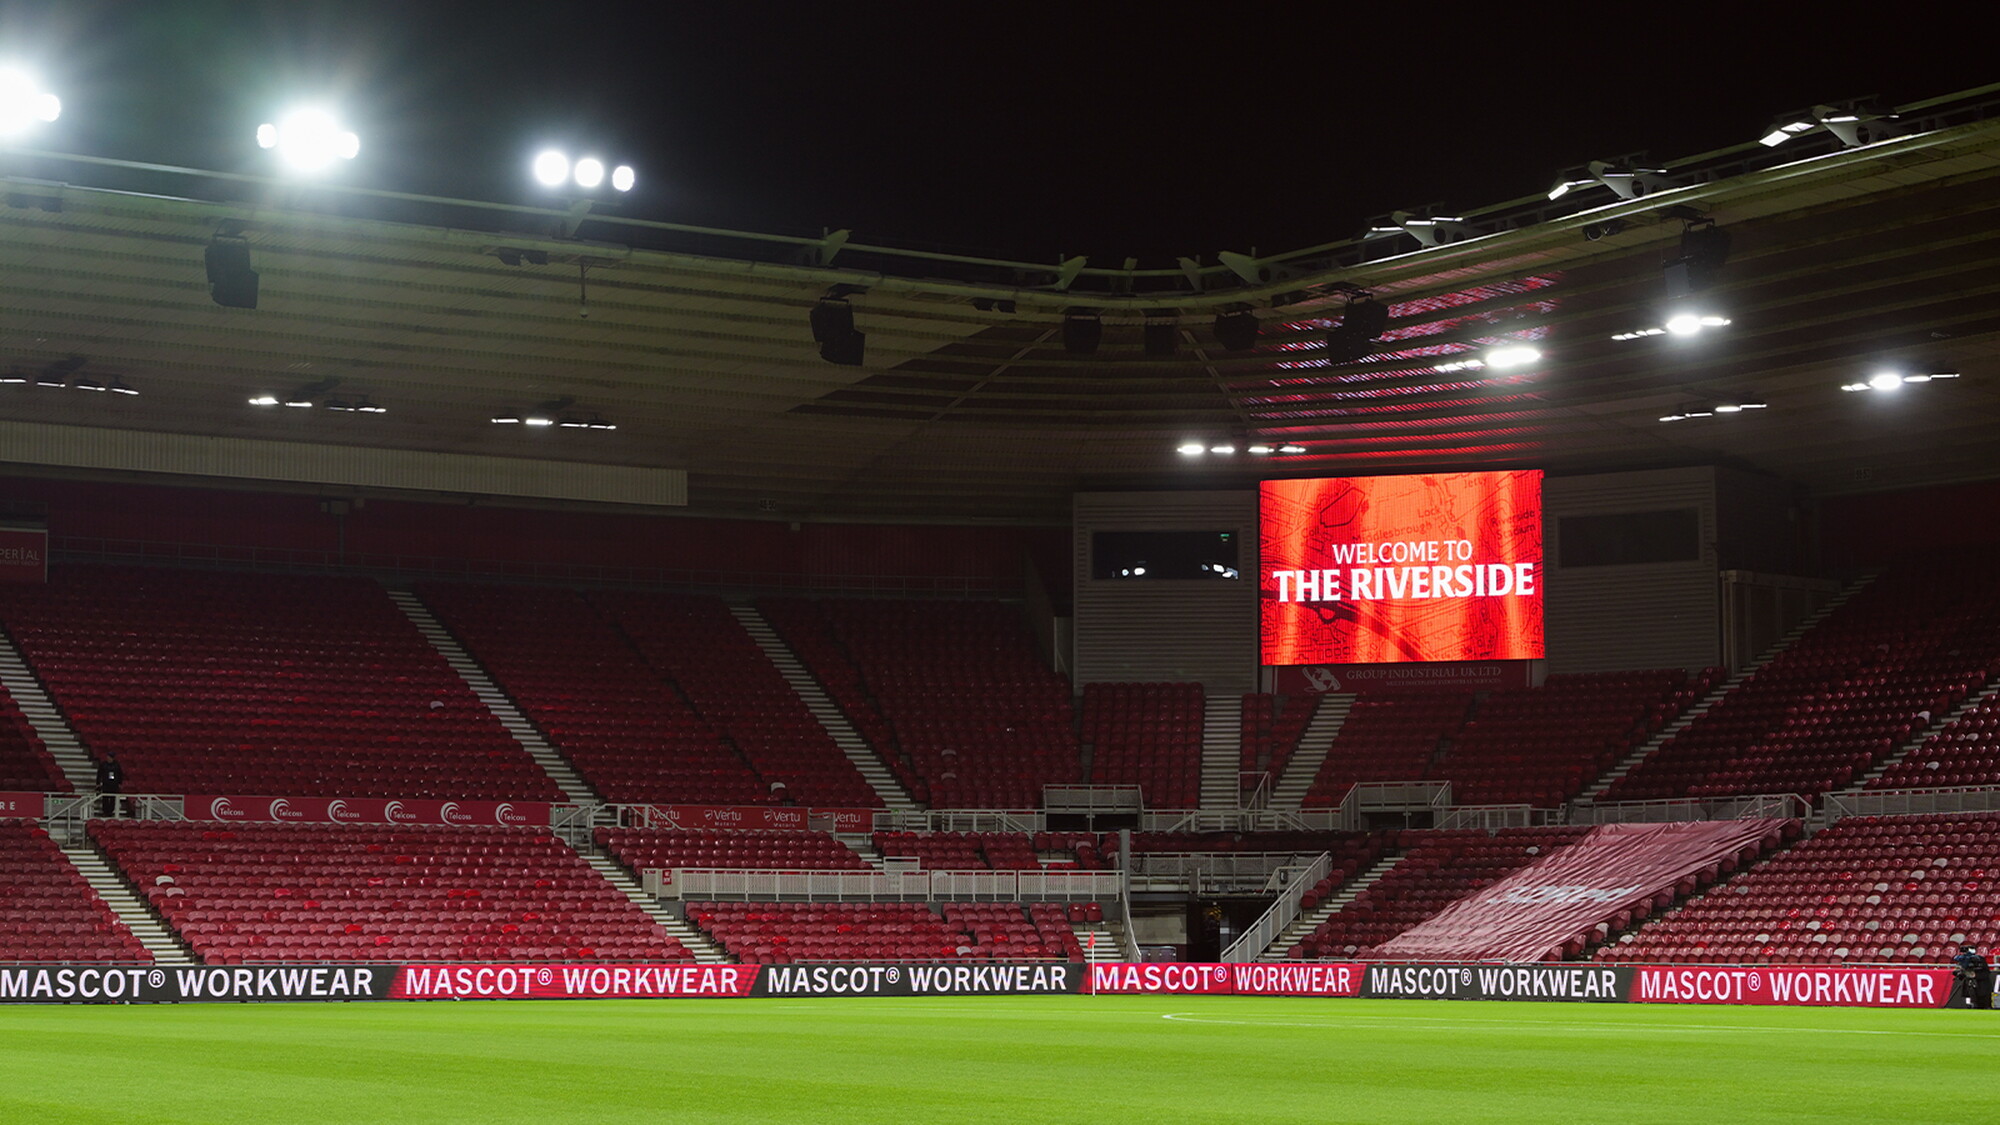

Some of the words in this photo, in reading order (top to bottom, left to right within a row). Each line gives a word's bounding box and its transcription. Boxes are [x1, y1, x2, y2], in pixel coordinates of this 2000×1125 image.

[1464, 478, 1487, 489] Jetty
[1418, 507, 1441, 518] Lock
[1490, 510, 1536, 526] Riverside
[1352, 521, 1433, 543] Middlesbrough
[1496, 523, 1537, 540] Stadium
[1333, 541, 1438, 564] WELCOME
[1444, 540, 1472, 560] TO
[1272, 569, 1341, 602] THE
[1350, 562, 1534, 600] RIVERSIDE
[1346, 669, 1387, 680] GROUP
[1388, 668, 1457, 679] INDUSTRIAL
[1460, 667, 1476, 678] UK
[1479, 666, 1502, 676] LTD
[219, 807, 244, 816] Telcoss
[278, 808, 303, 817] Telcoss
[336, 809, 360, 818] Telcoss
[393, 810, 417, 819] Telcoss
[449, 811, 472, 820] Telcoss
[504, 812, 526, 821] Telcoss
[714, 810, 742, 821] Vertu
[773, 811, 801, 822] Vertu
[835, 812, 861, 823] Vertu
[1, 969, 166, 997] MASCOT®
[176, 968, 373, 996] WORKWEAR
[405, 967, 553, 994] MASCOT®
[563, 967, 738, 994] WORKWEAR
[768, 966, 900, 992] MASCOT®
[909, 965, 1066, 992] WORKWEAR
[1095, 965, 1227, 990] MASCOT®
[1235, 966, 1350, 992] WORKWEAR
[1371, 967, 1472, 994] MASCOT®
[1479, 968, 1616, 998] WORKWEAR
[1641, 970, 1761, 999] MASCOT®
[1769, 972, 1934, 1004] WORKWEAR
